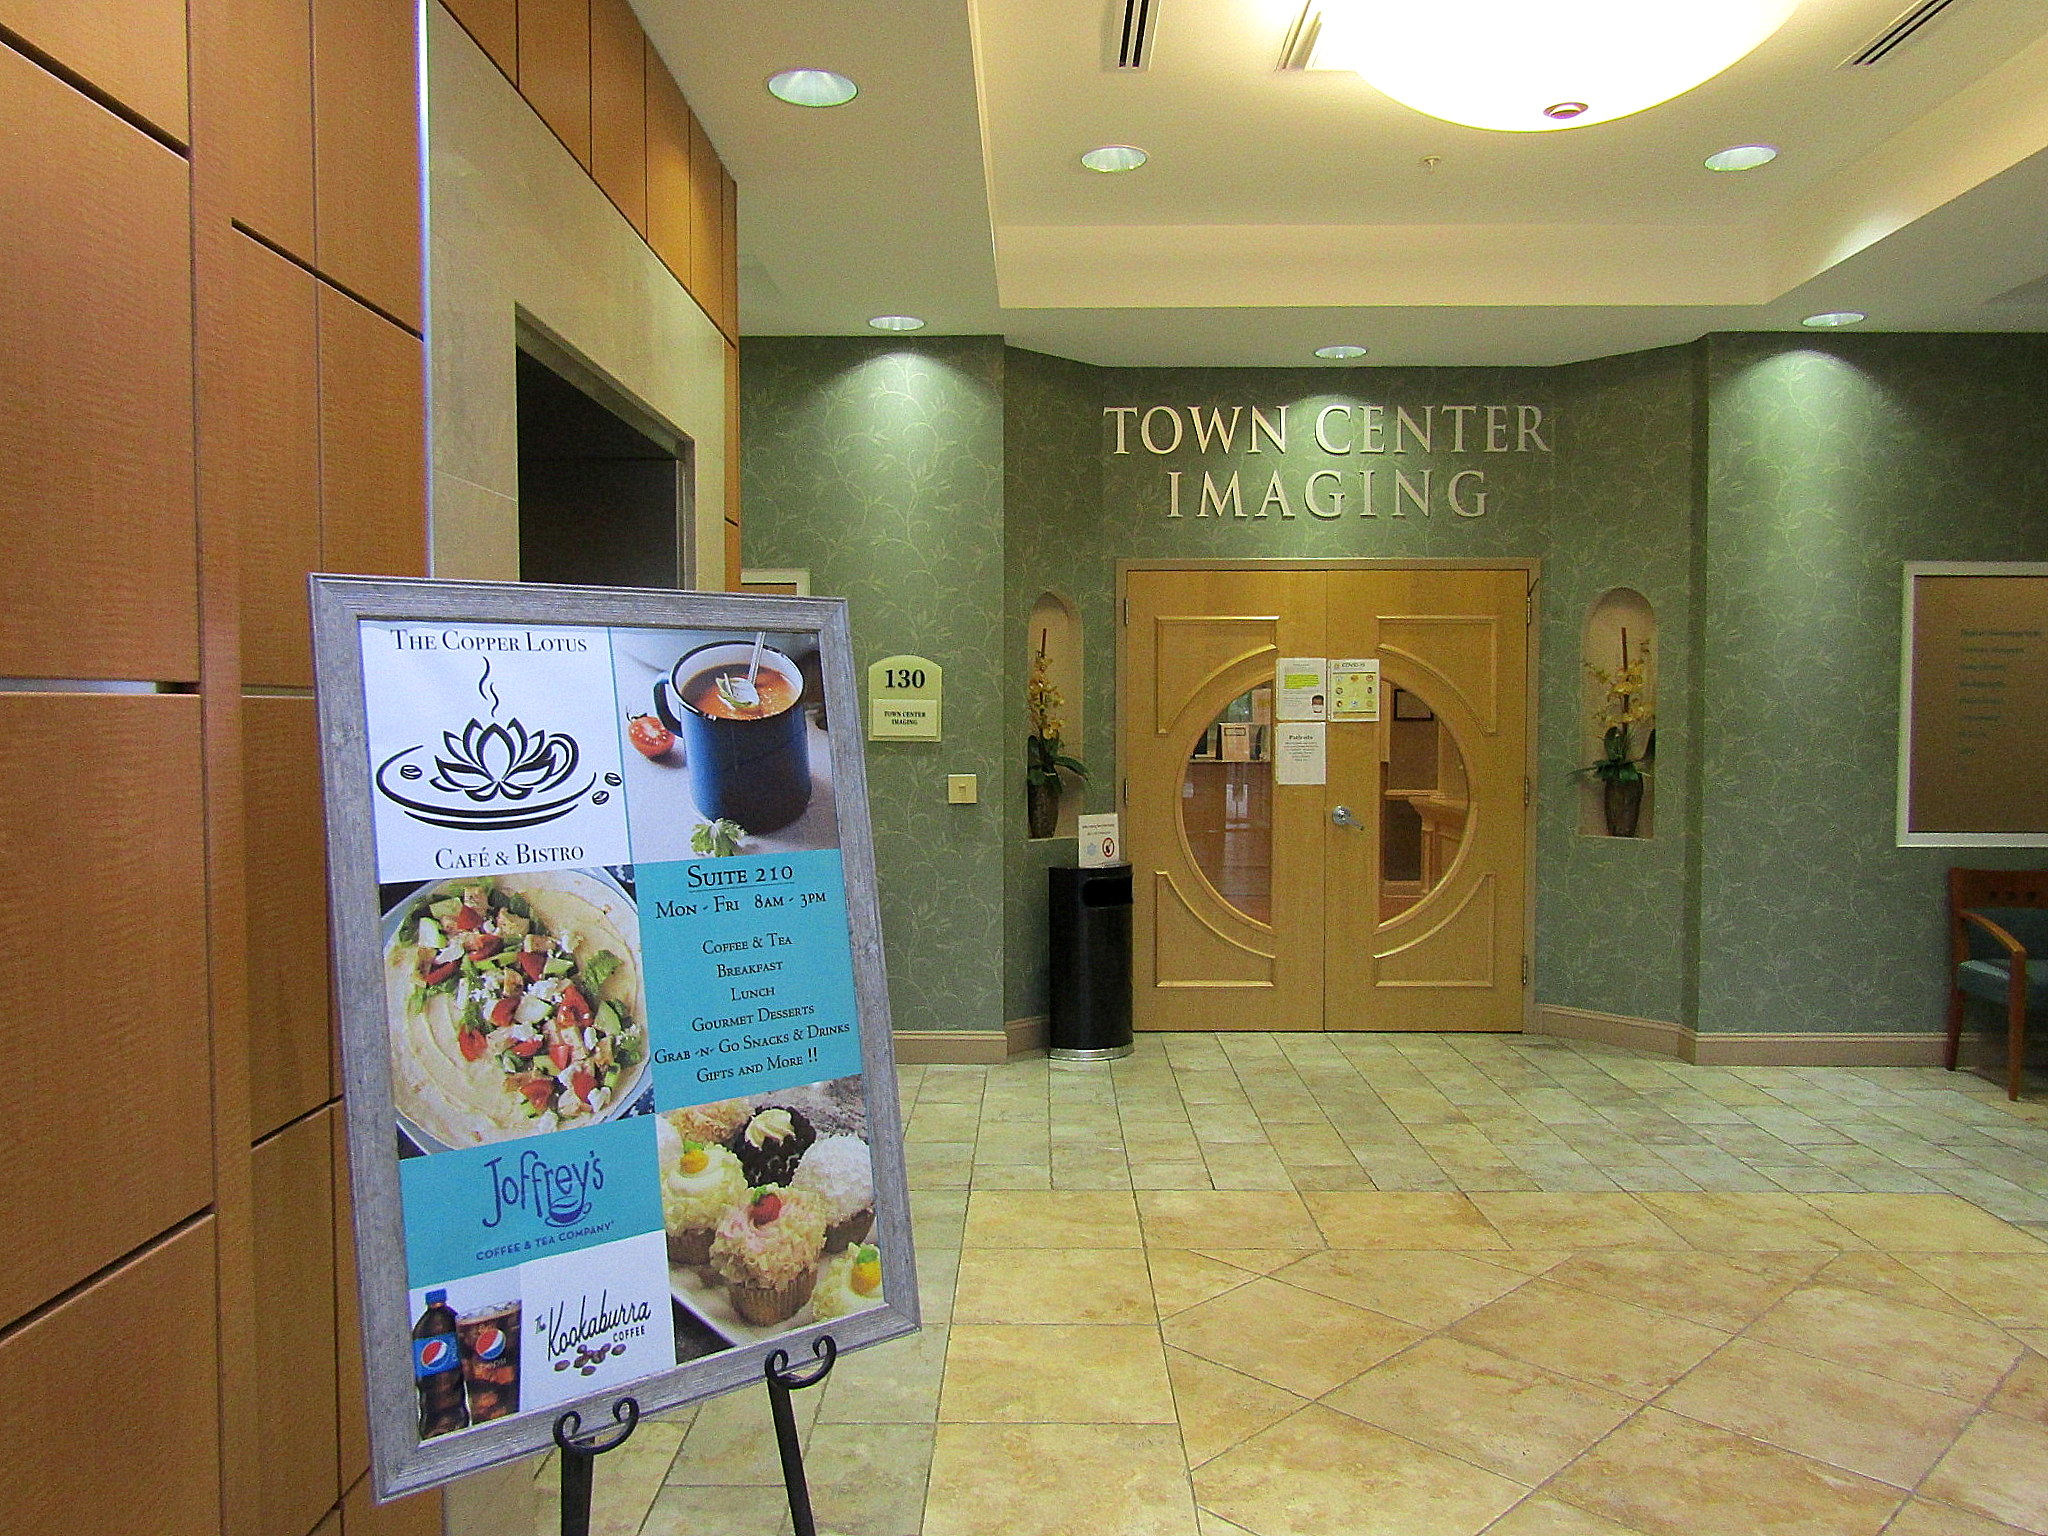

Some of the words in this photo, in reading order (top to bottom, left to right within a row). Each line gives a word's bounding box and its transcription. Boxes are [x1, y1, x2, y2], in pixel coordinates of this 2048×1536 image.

[1102, 405, 1290, 455] TOWN
[1314, 404, 1551, 456] CENTER
[1166, 469, 1487, 520] IMAGING
[390, 629, 437, 650] THE
[442, 629, 520, 651] COPPER
[525, 631, 587, 652] LOTUS
[885, 669, 925, 689] 130
[884, 710, 901, 718] TOWN
[891, 718, 918, 726] IMAGING
[435, 847, 491, 870] CAFÉ
[495, 851, 510, 866] &
[514, 843, 584, 865] BISTRO
[687, 865, 748, 889] SUITE
[755, 866, 793, 883] 210
[655, 900, 697, 919] MON
[713, 895, 740, 913] FRI
[754, 894, 784, 909] 8AM
[800, 892, 826, 909] 3PM
[702, 939, 749, 955] COFFEE
[752, 936, 763, 949] &
[766, 932, 793, 947] TEA
[716, 961, 783, 978] BREAKFAST
[731, 986, 775, 1002] LUNCH
[692, 1013, 754, 1032] GOURMET
[758, 1004, 815, 1022] DESSERTS
[654, 1048, 690, 1064] GRAB
[718, 1039, 740, 1054] GO
[743, 1034, 789, 1050] SNACKS
[793, 1028, 804, 1041] &
[807, 1022, 850, 1039] DRINKS
[697, 1067, 734, 1082] GIFTS
[738, 1064, 763, 1076] AND
[767, 1054, 803, 1071] MORE
[482, 1150, 604, 1227] Joffrey's
[476, 1242, 521, 1261] COFFEE
[524, 1241, 532, 1250] &
[535, 1236, 556, 1247] TEA
[558, 1221, 612, 1242] COMPANY
[548, 1289, 651, 1361] Kookaburra
[613, 1325, 645, 1342] COFFEE
